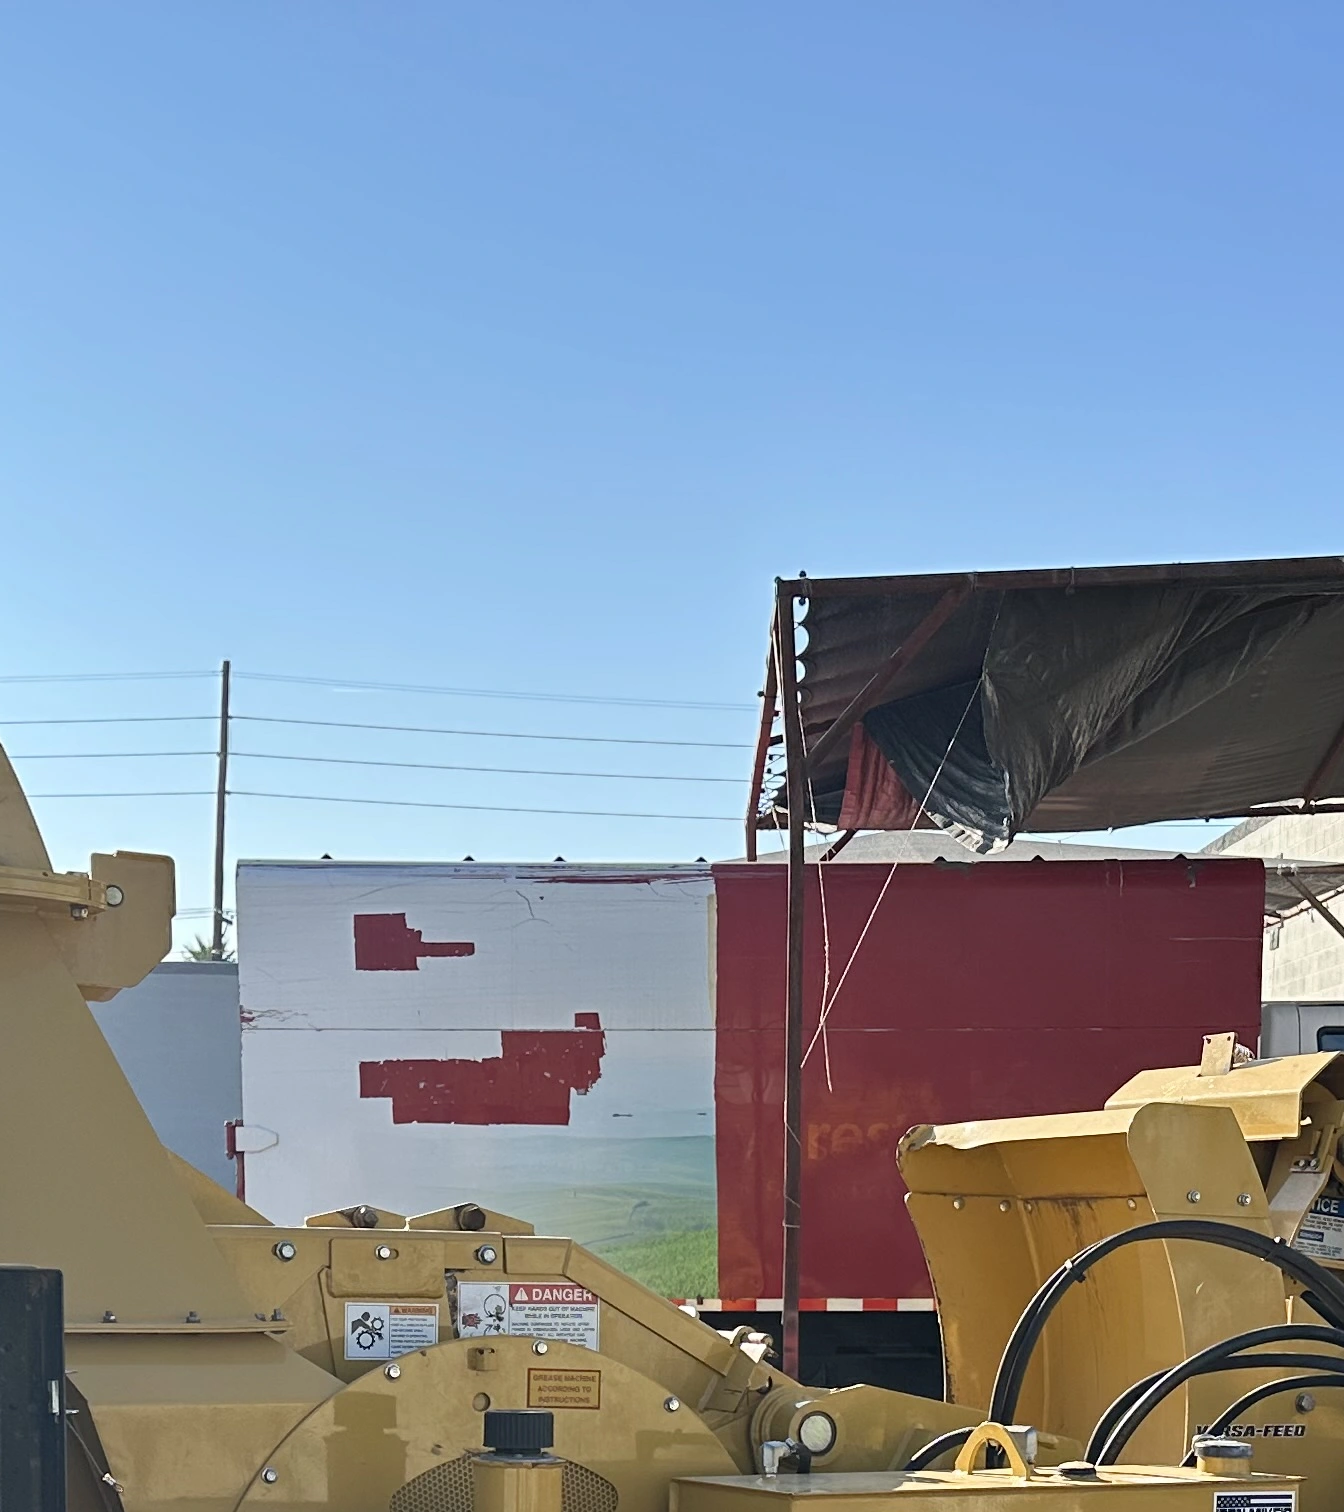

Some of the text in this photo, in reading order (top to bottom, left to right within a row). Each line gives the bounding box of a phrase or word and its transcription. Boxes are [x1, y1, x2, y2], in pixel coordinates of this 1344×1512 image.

[532, 1288, 593, 1301] DANGER
[538, 1396, 590, 1404] INSTRUCTIONS
[1196, 1425, 1306, 1437] VSA-FEED
